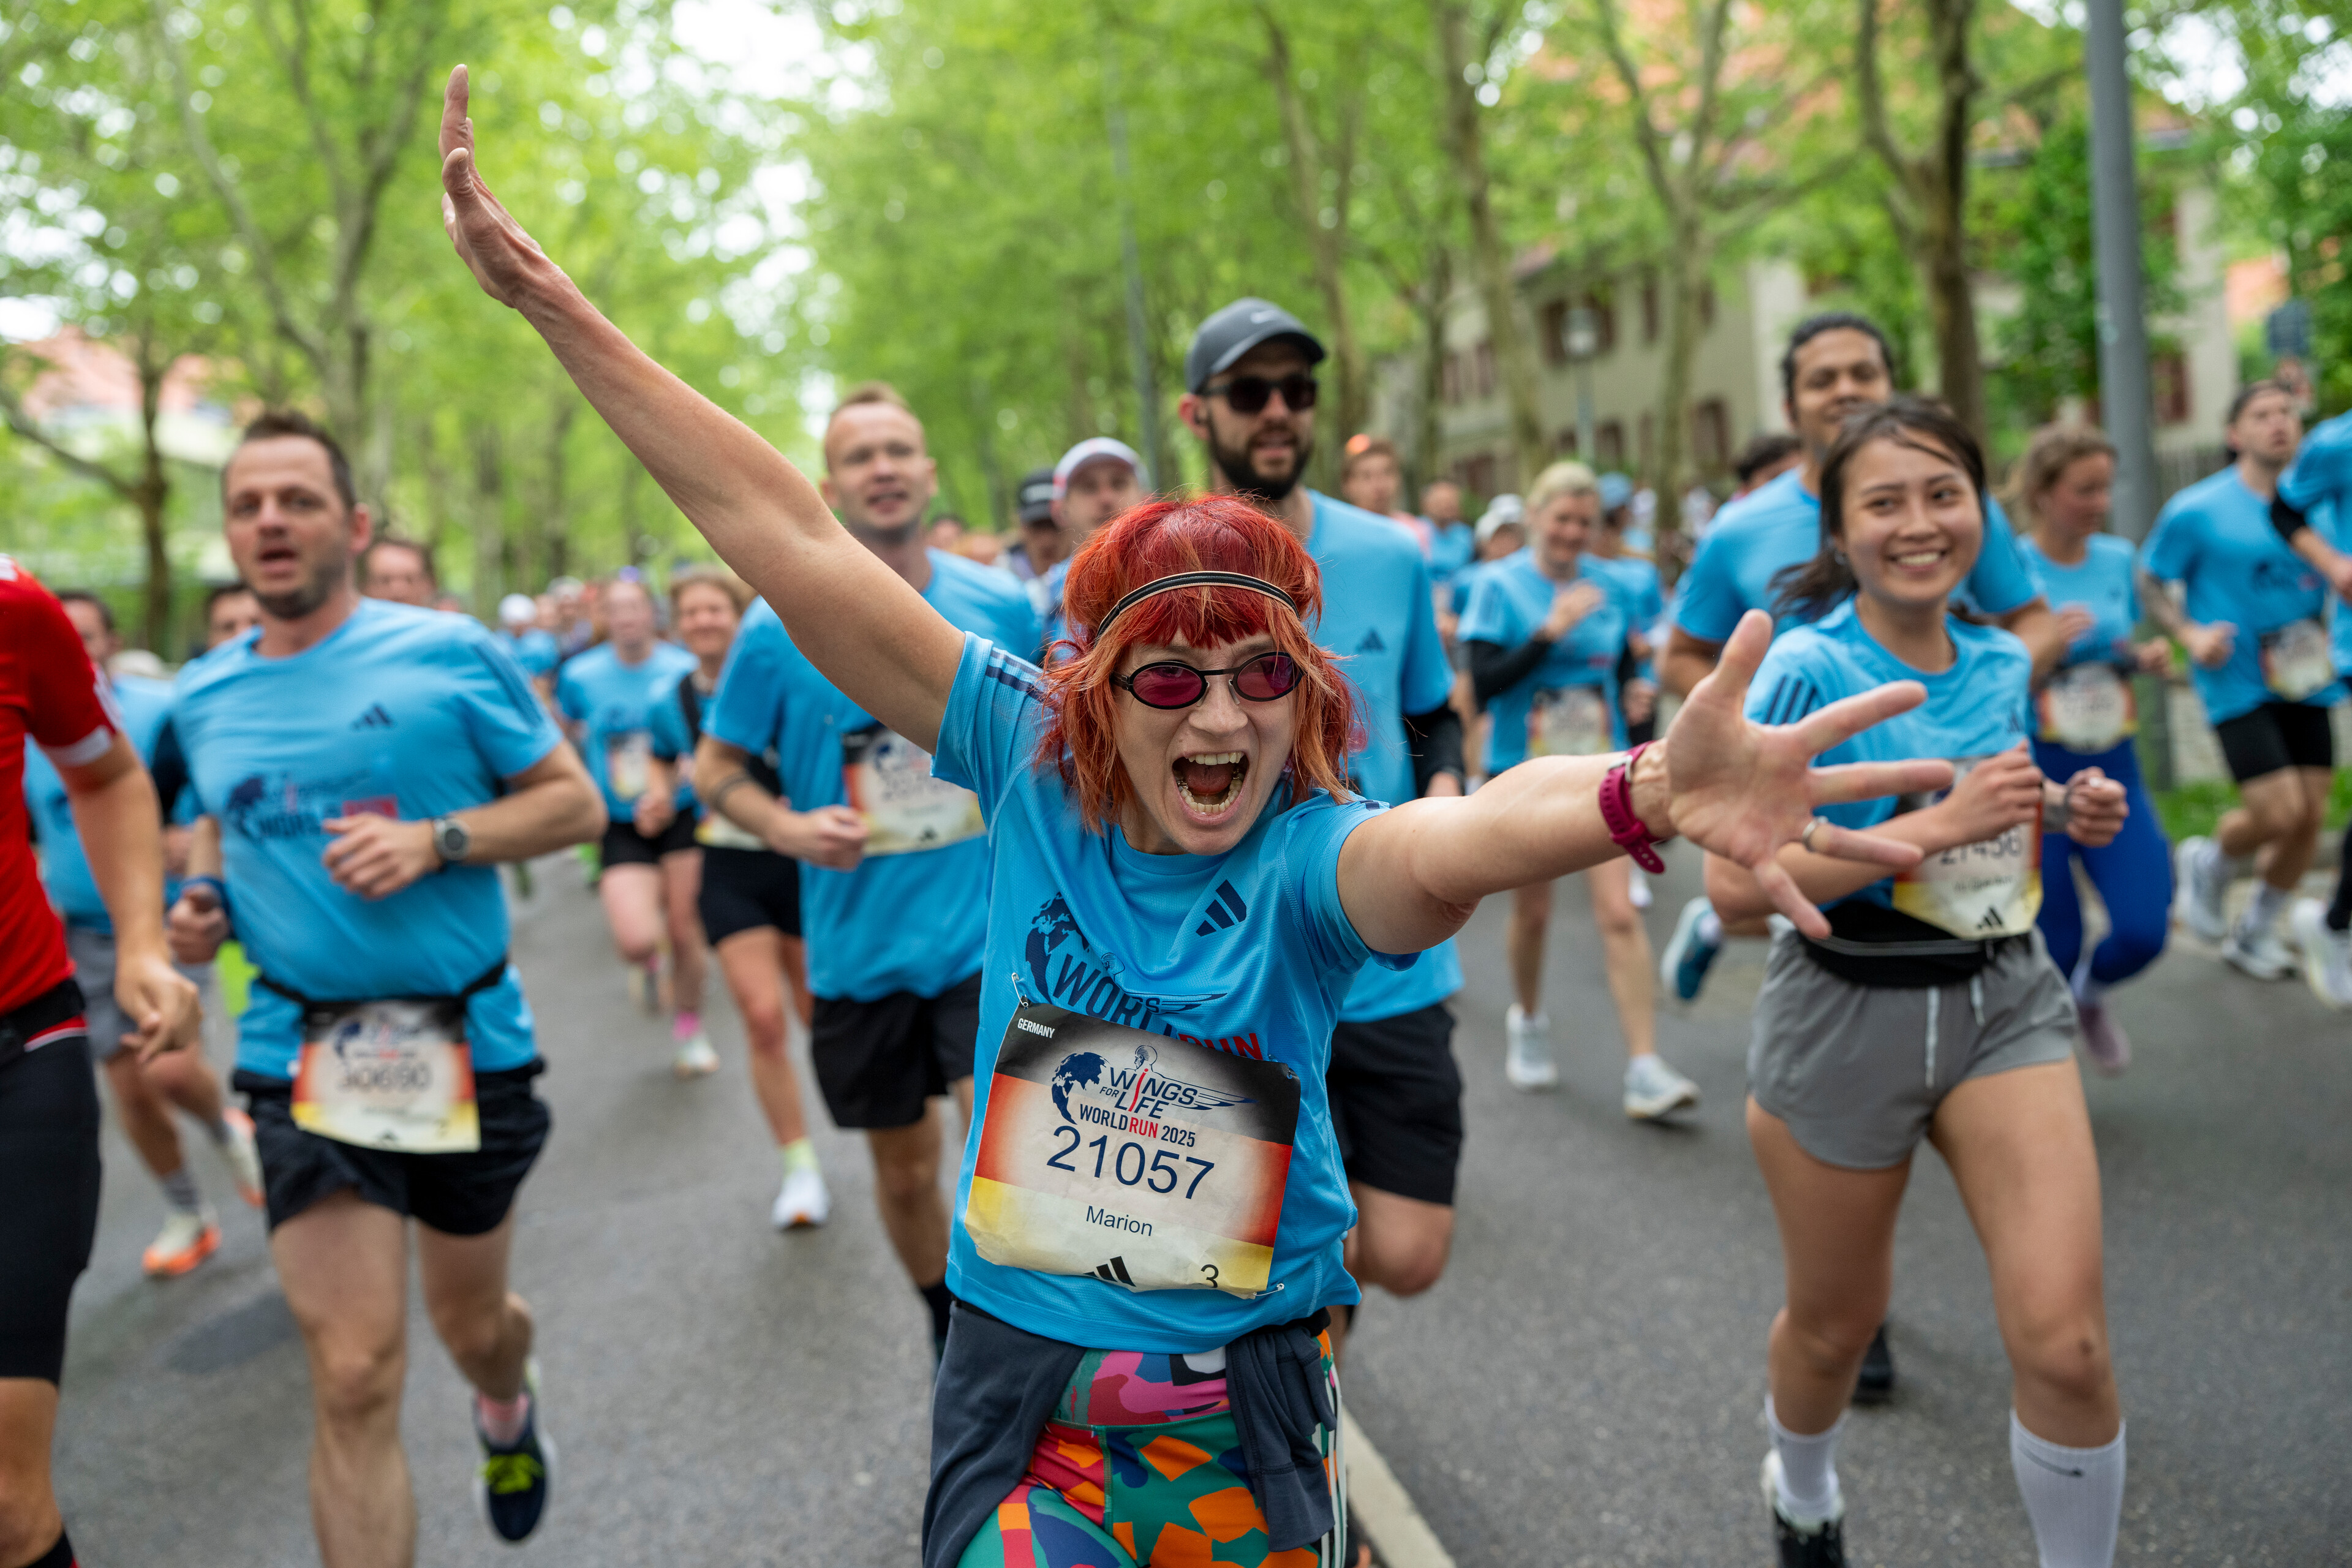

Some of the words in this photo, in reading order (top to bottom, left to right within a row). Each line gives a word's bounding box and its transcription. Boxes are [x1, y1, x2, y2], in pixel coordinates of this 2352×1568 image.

[1017, 1017, 1055, 1039] GERMANY
[1099, 1087, 1119, 1098] FOR
[1161, 1125, 1196, 1147] 2025
[1046, 1125, 1215, 1199] 21057
[1086, 1205, 1153, 1236] Marion
[1200, 1264, 1219, 1289] 3
